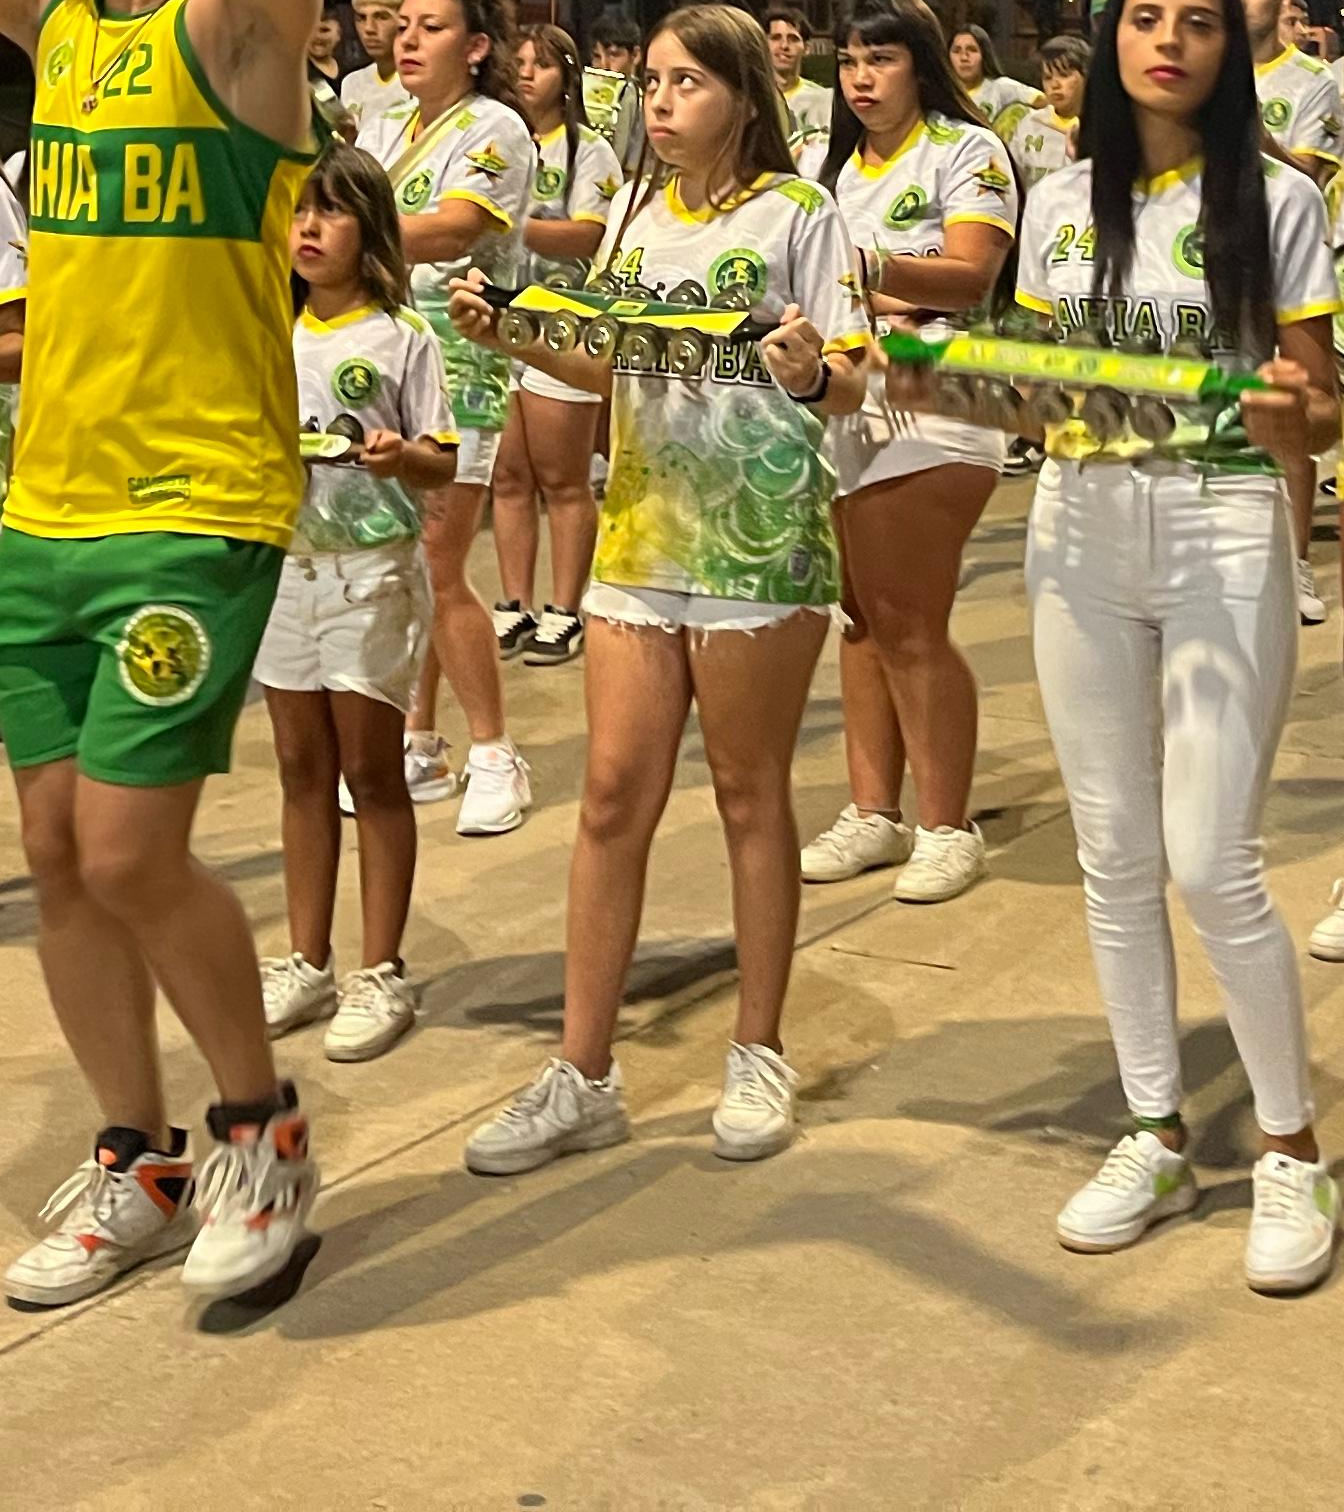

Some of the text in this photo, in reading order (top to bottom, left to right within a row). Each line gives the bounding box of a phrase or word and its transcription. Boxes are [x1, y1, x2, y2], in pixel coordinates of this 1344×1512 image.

[103, 42, 153, 99] 22
[30, 139, 205, 224] HIA BA
[1051, 223, 1096, 263] 24
